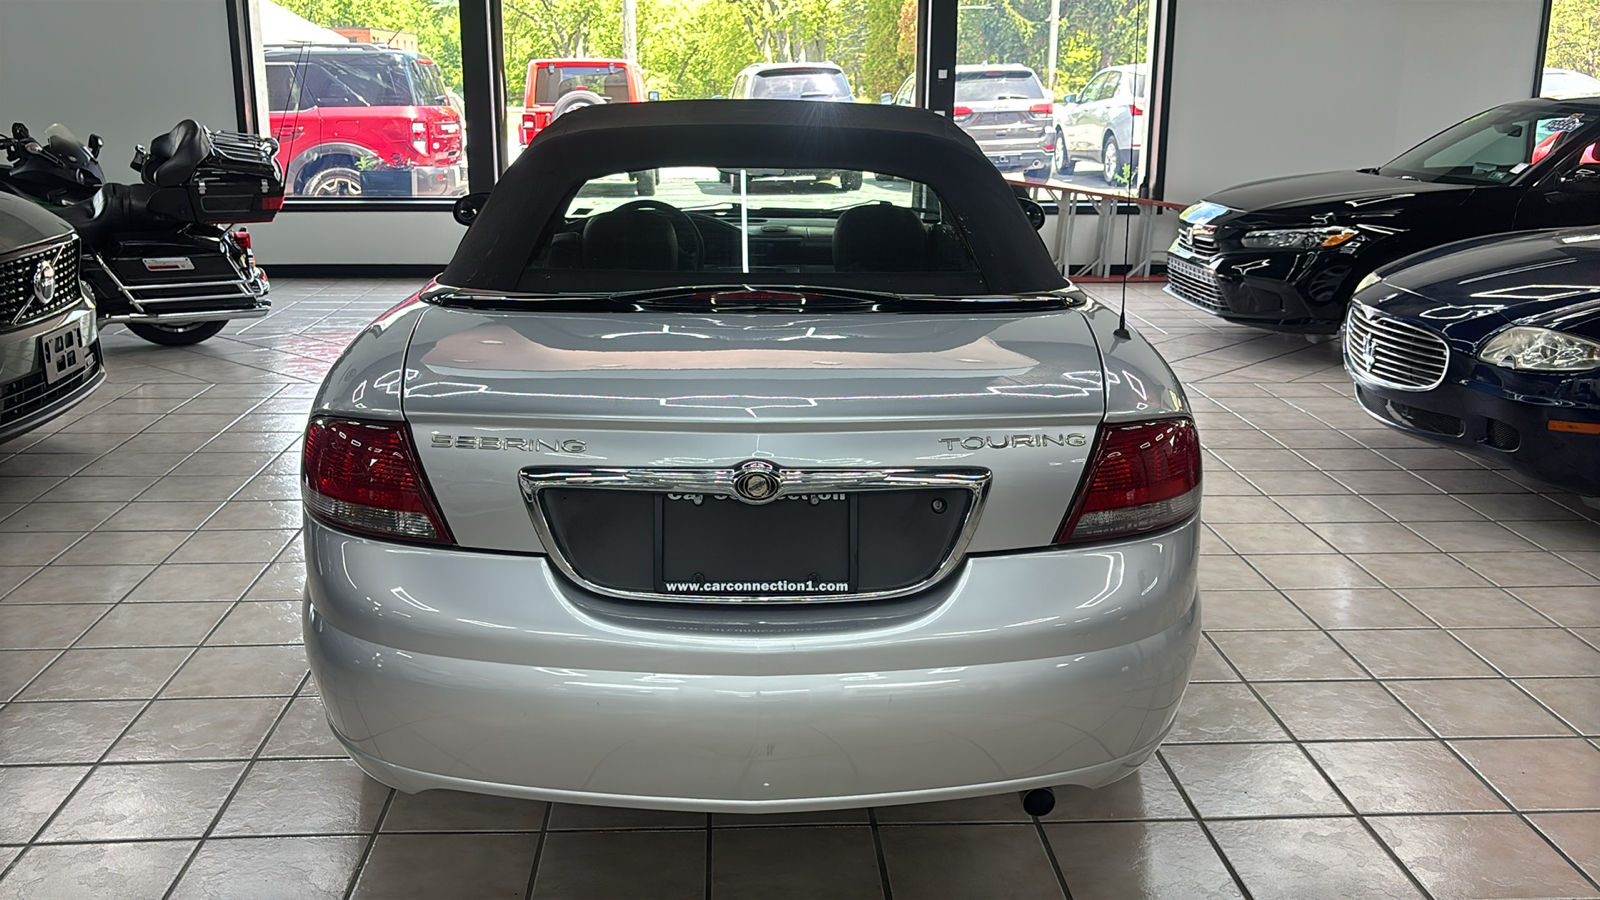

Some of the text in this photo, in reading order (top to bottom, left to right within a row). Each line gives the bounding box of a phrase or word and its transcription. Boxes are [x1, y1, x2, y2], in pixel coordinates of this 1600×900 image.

[431, 434, 587, 453] SEBRING
[938, 433, 1087, 451] TOURING
[666, 580, 849, 591] www.carconnection1.com
